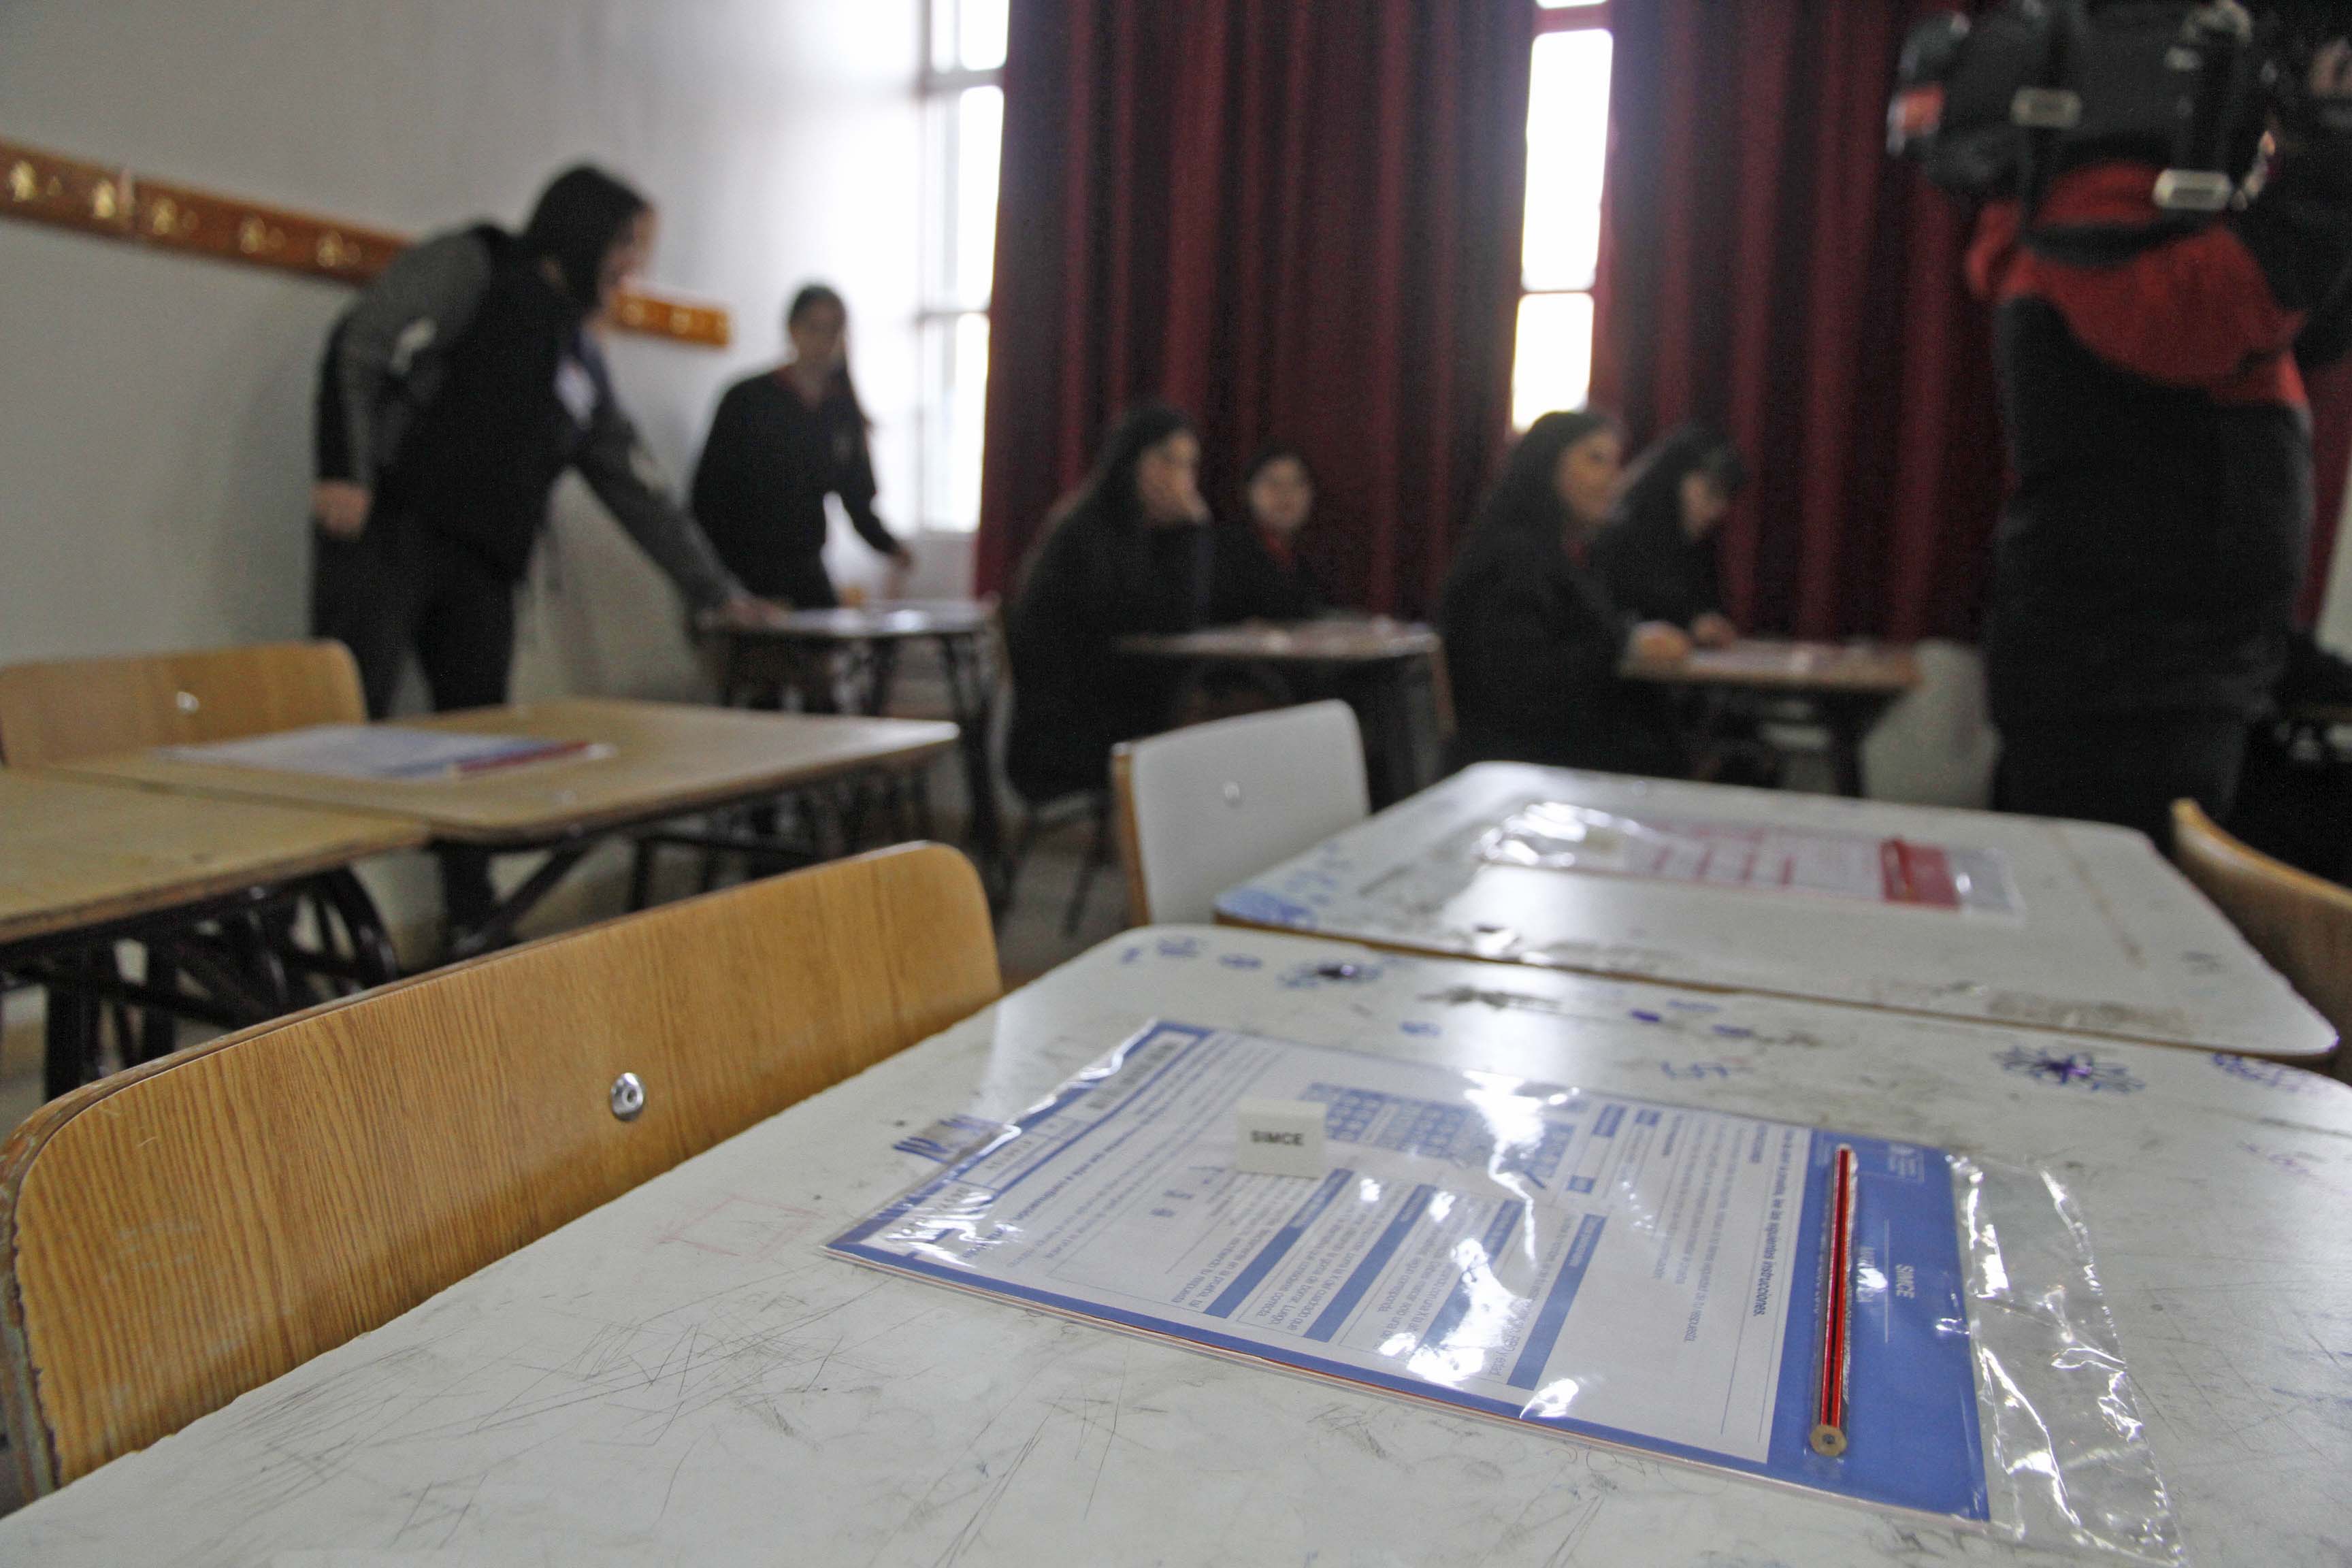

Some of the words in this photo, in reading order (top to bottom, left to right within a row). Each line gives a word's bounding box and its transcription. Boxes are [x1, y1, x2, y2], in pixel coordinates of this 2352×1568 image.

[1250, 1130, 1305, 1146] SIMCE
[1751, 1259, 1776, 1319] instrucciones.
[1895, 1263, 1914, 1299] SIMCE
[1264, 1303, 1296, 1328] Luego,
[1294, 1288, 1329, 1319] cuadrado
[1282, 1316, 1306, 1332] que
